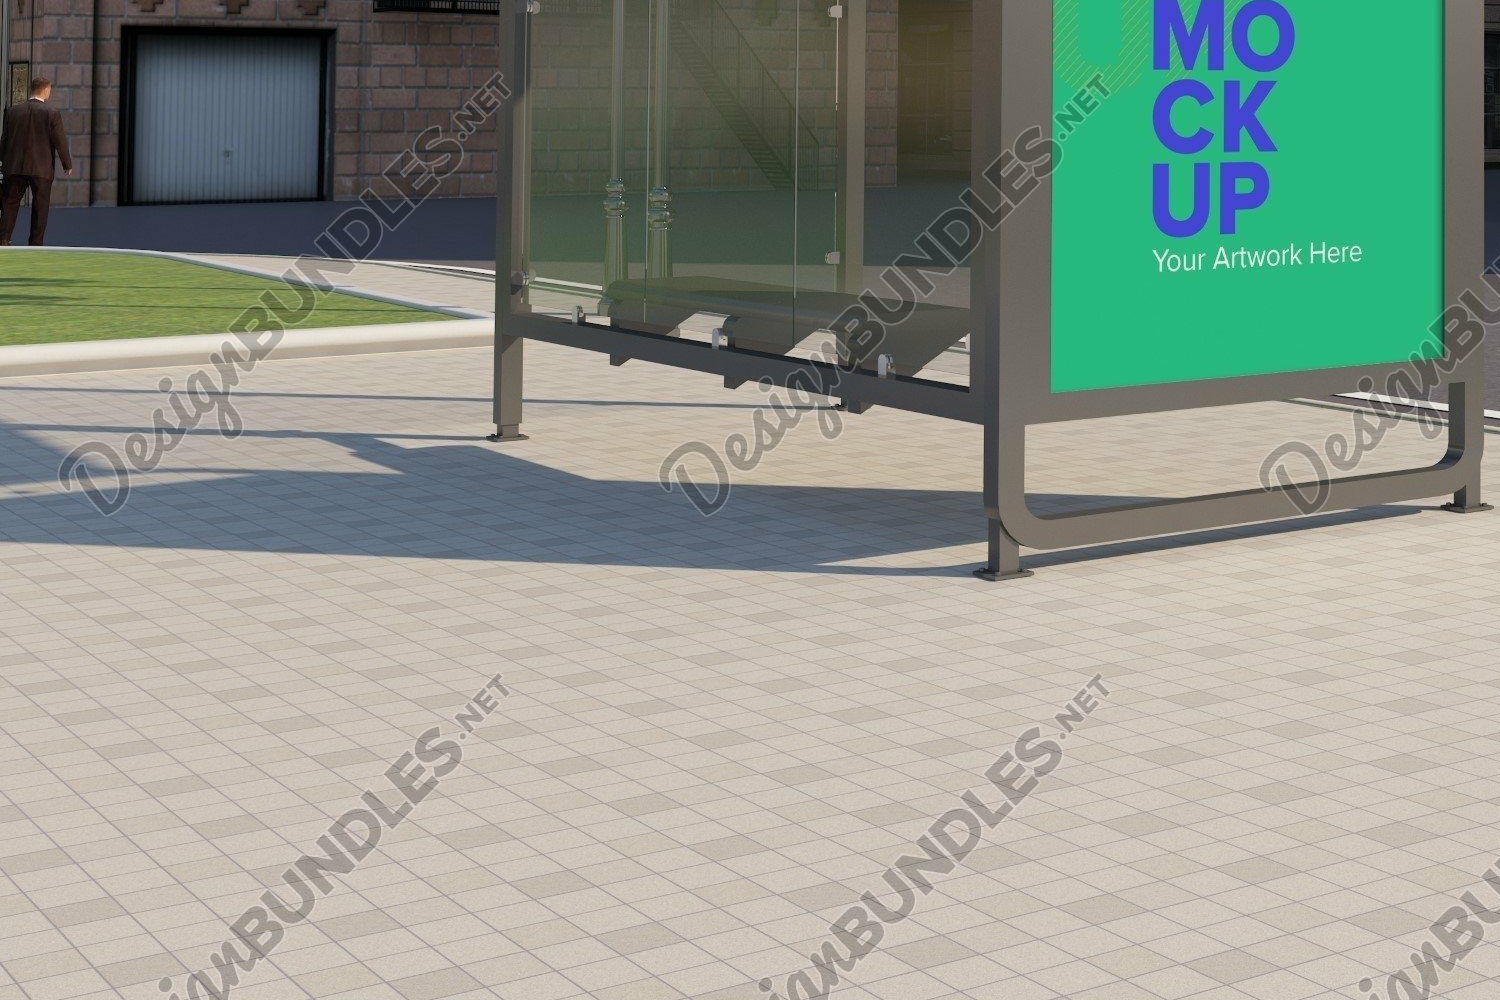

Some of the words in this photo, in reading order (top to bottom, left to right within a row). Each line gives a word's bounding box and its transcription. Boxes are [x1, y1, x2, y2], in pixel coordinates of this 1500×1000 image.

[1152, 78, 1278, 154] CK
[1152, 161, 1270, 238] UP
[1153, 249, 1206, 272] Your
[1212, 243, 1302, 270] Artwork
[1310, 242, 1362, 265] Here
